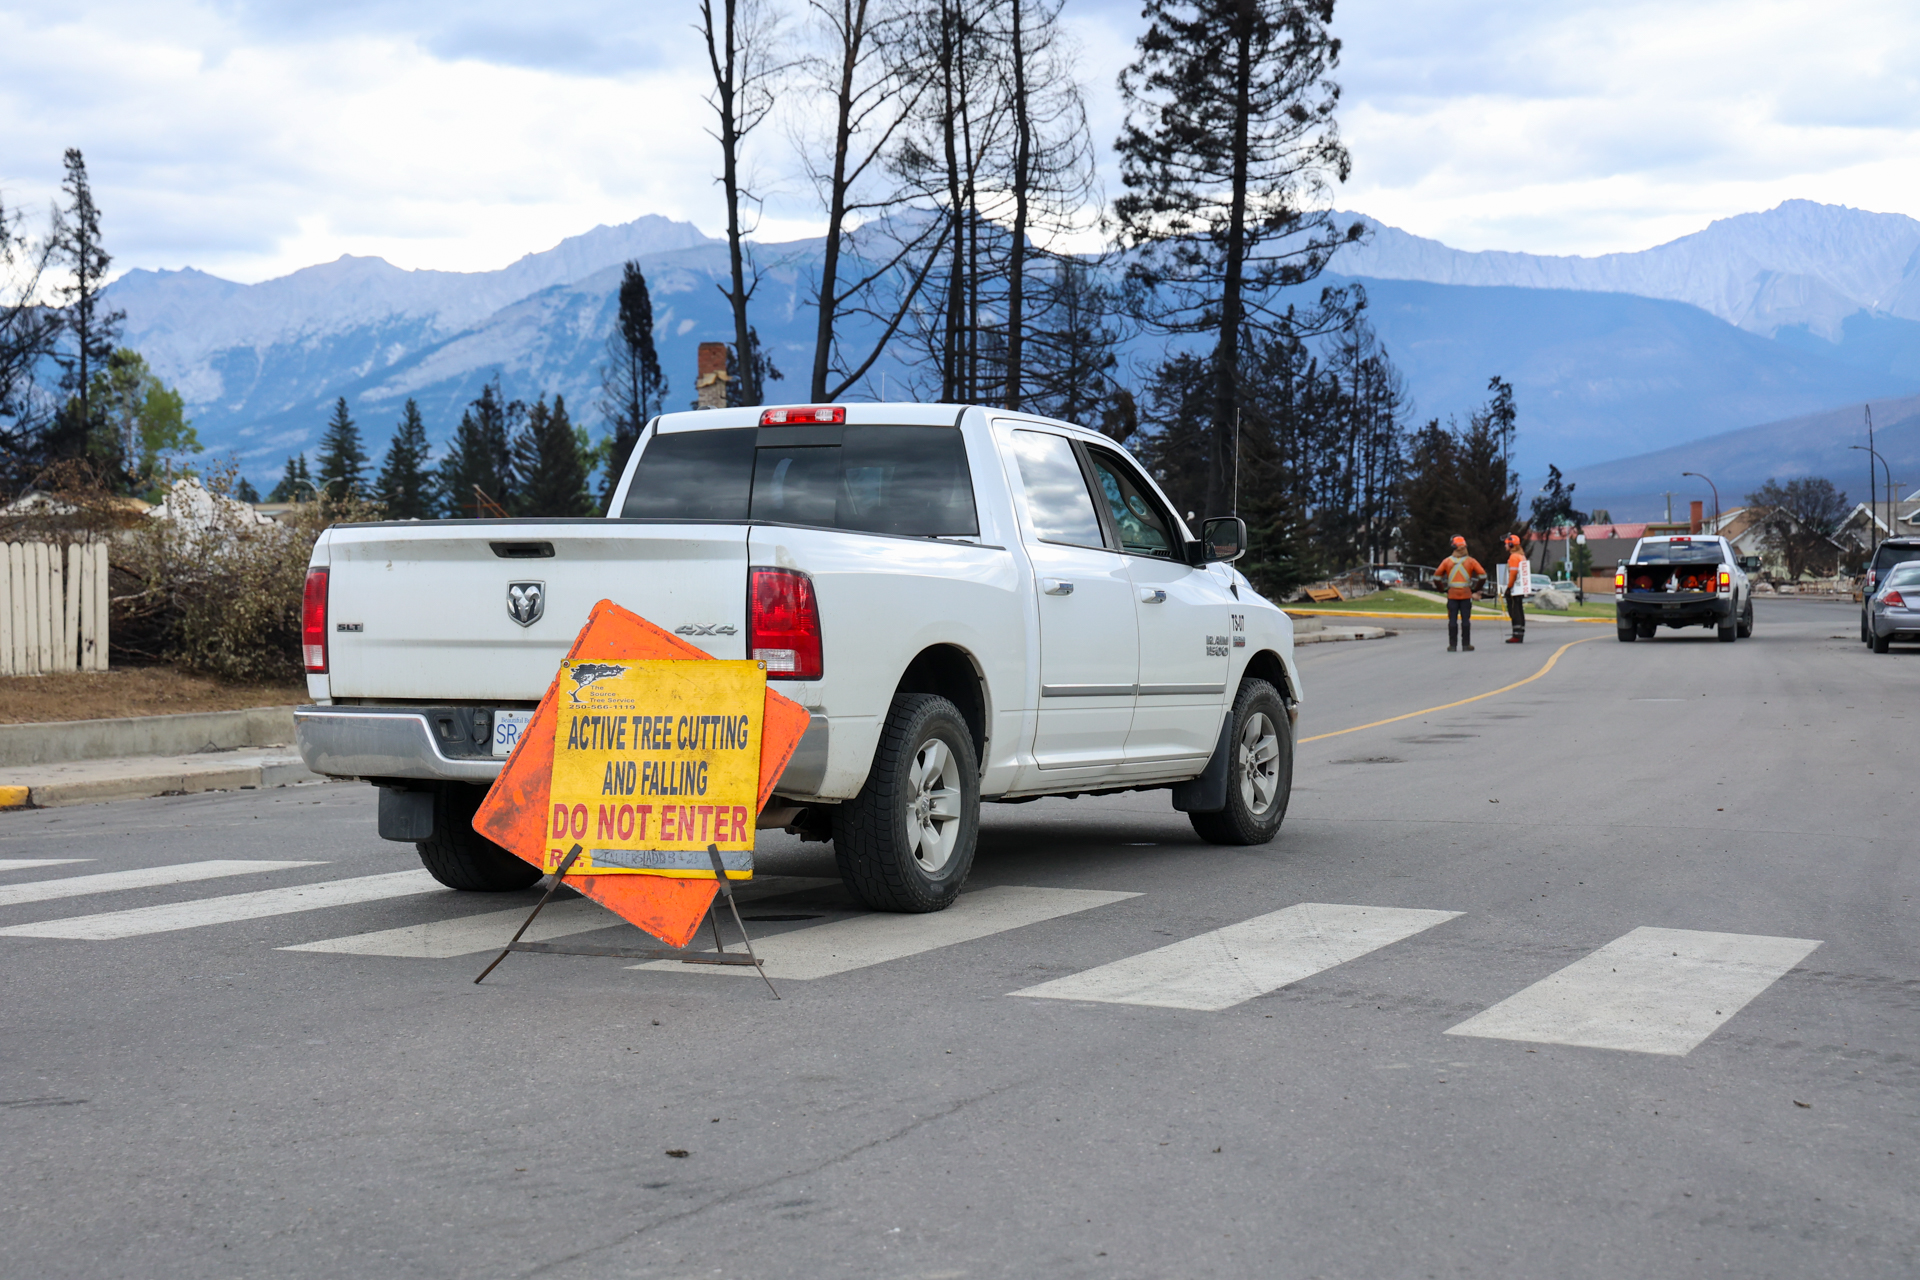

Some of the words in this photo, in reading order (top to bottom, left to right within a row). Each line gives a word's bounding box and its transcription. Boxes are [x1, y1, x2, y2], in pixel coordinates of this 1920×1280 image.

[338, 623, 361, 631] SLT
[1206, 646, 1228, 656] 1500
[567, 716, 627, 750] ACTIVE
[632, 716, 672, 750] TREE
[677, 715, 749, 750] CUTTING
[601, 761, 636, 796] AND
[640, 761, 708, 796] FALLING
[552, 803, 588, 840] DO
[597, 804, 652, 841] NOT
[660, 805, 748, 842] ENTER
